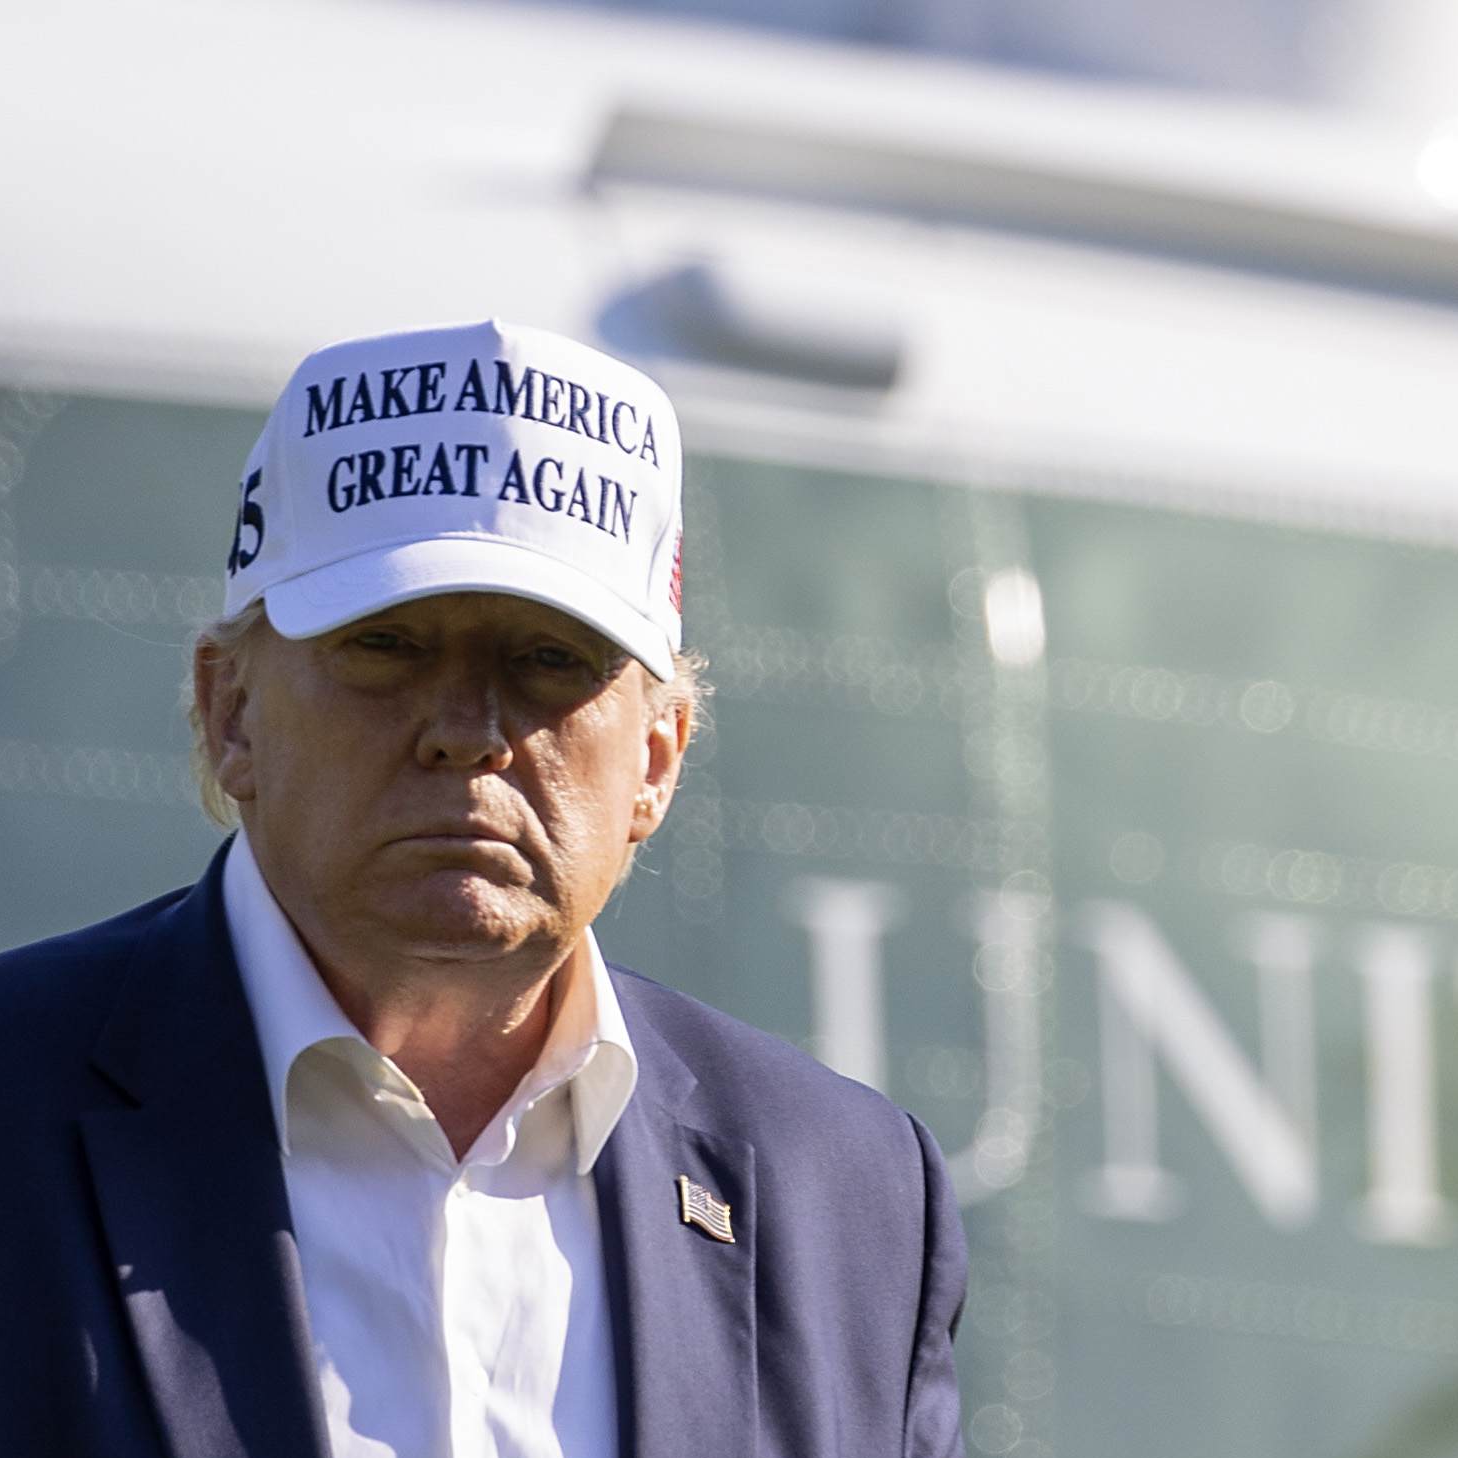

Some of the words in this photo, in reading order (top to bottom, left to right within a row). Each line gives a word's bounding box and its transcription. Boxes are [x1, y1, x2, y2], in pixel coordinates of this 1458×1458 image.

[303, 360, 447, 438] MAKE
[454, 358, 662, 470] AMERICA
[327, 441, 490, 514] GREAT
[498, 448, 638, 545] AGAIN
